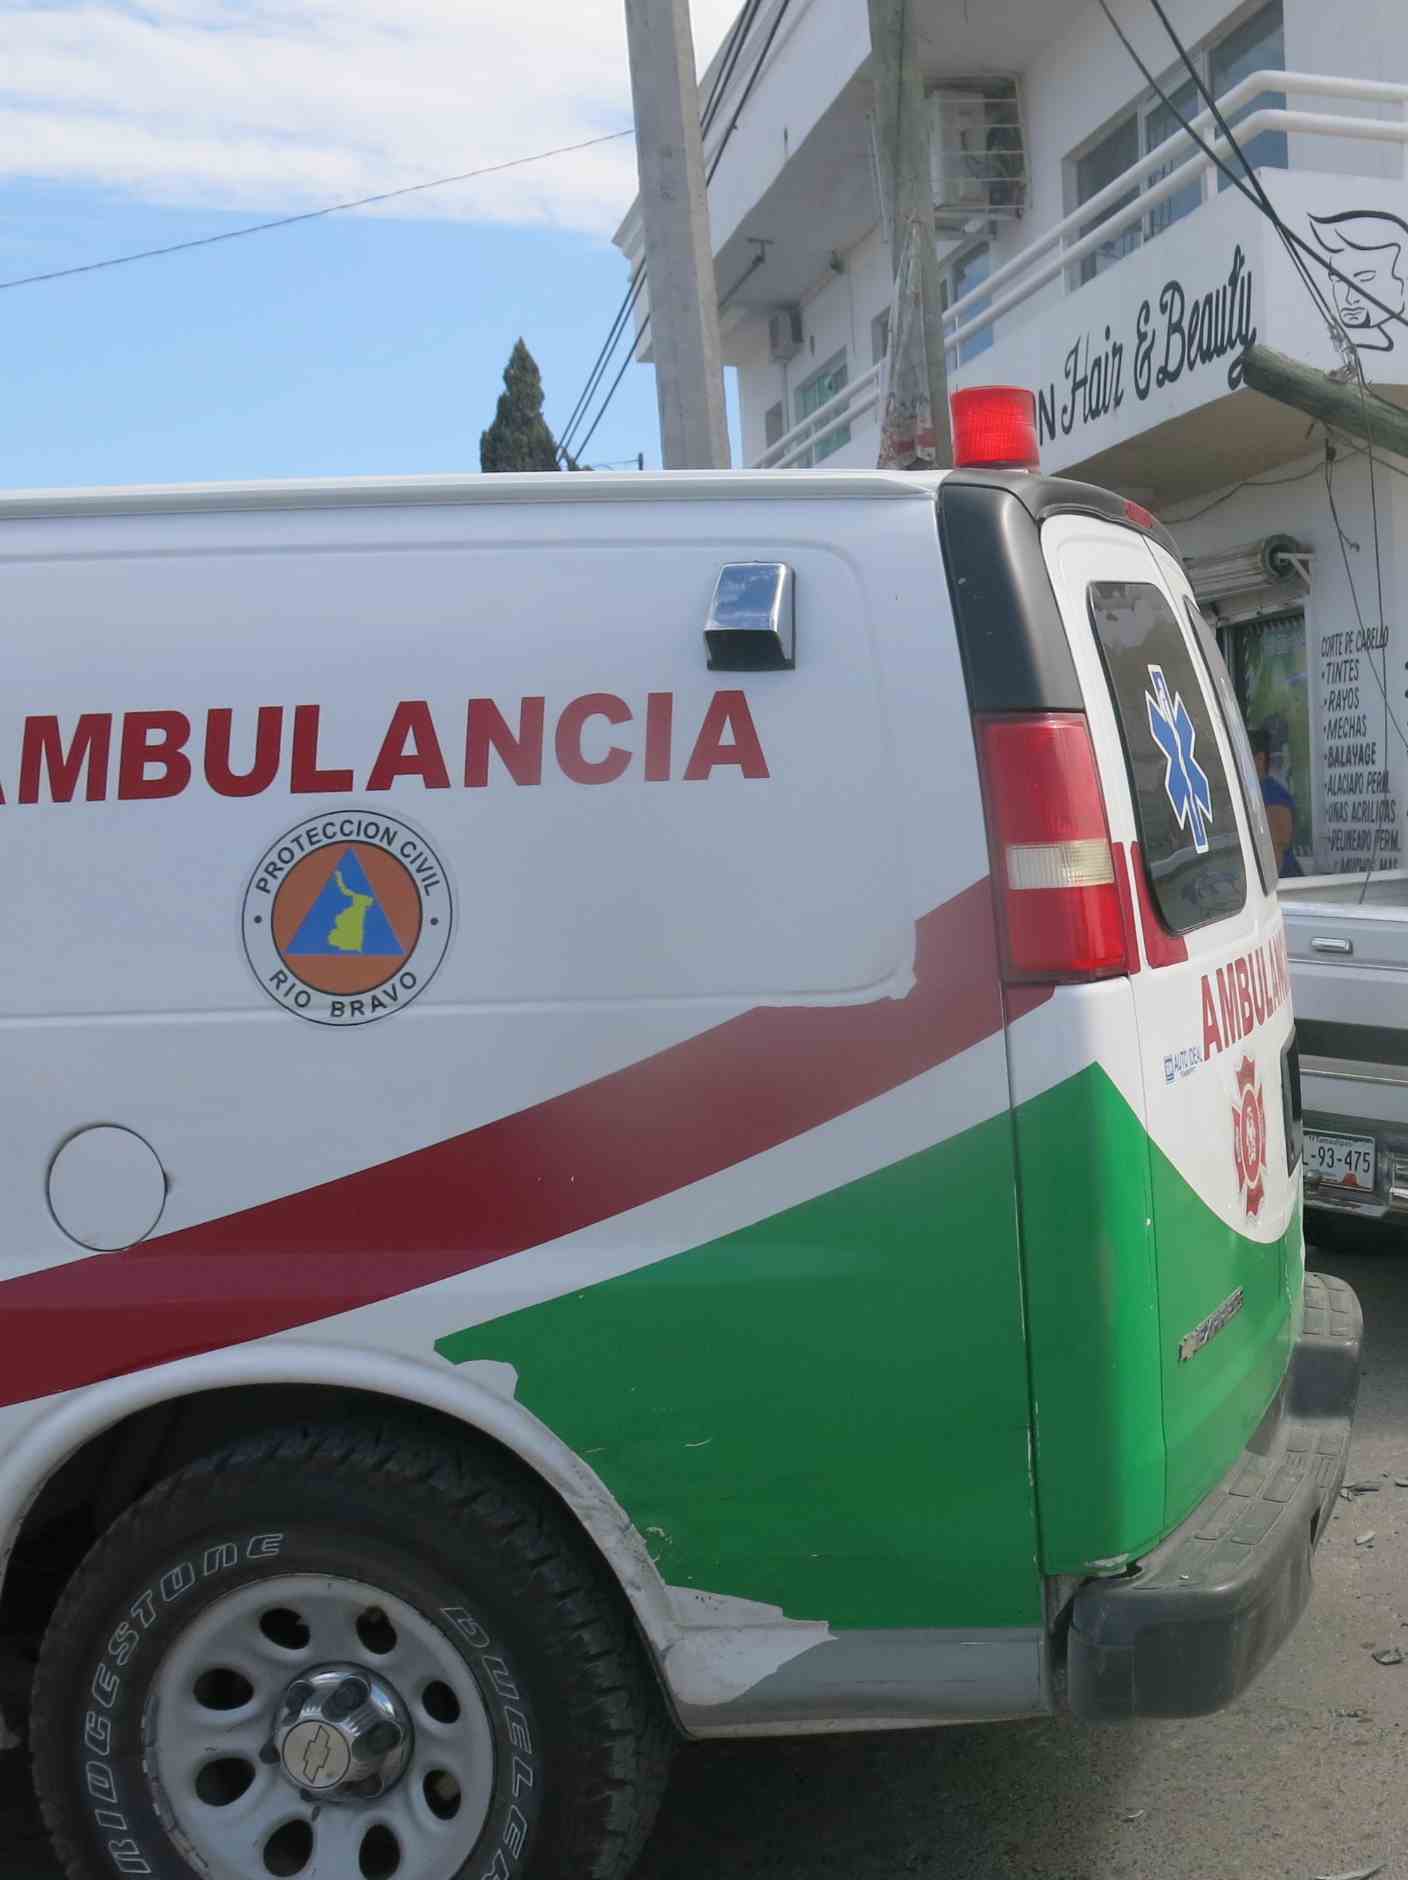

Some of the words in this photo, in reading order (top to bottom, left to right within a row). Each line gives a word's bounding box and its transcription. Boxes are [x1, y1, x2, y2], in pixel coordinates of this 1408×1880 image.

[1061, 325, 1124, 435] Hair
[1134, 300, 1156, 401] &
[1156, 244, 1257, 391] Beauty
[1321, 632, 1344, 657] CORTE
[1326, 659, 1360, 684] TINTES
[1328, 687, 1360, 712] RAYOS
[1327, 714, 1367, 740] MECHAS
[0, 690, 770, 805] MBULANCIA
[1328, 741, 1377, 768] BALAYAGE
[256, 819, 397, 894] PROTECCION
[400, 841, 440, 896] CIVIL
[270, 968, 311, 1008] RIO
[330, 971, 417, 1018] BRAVO
